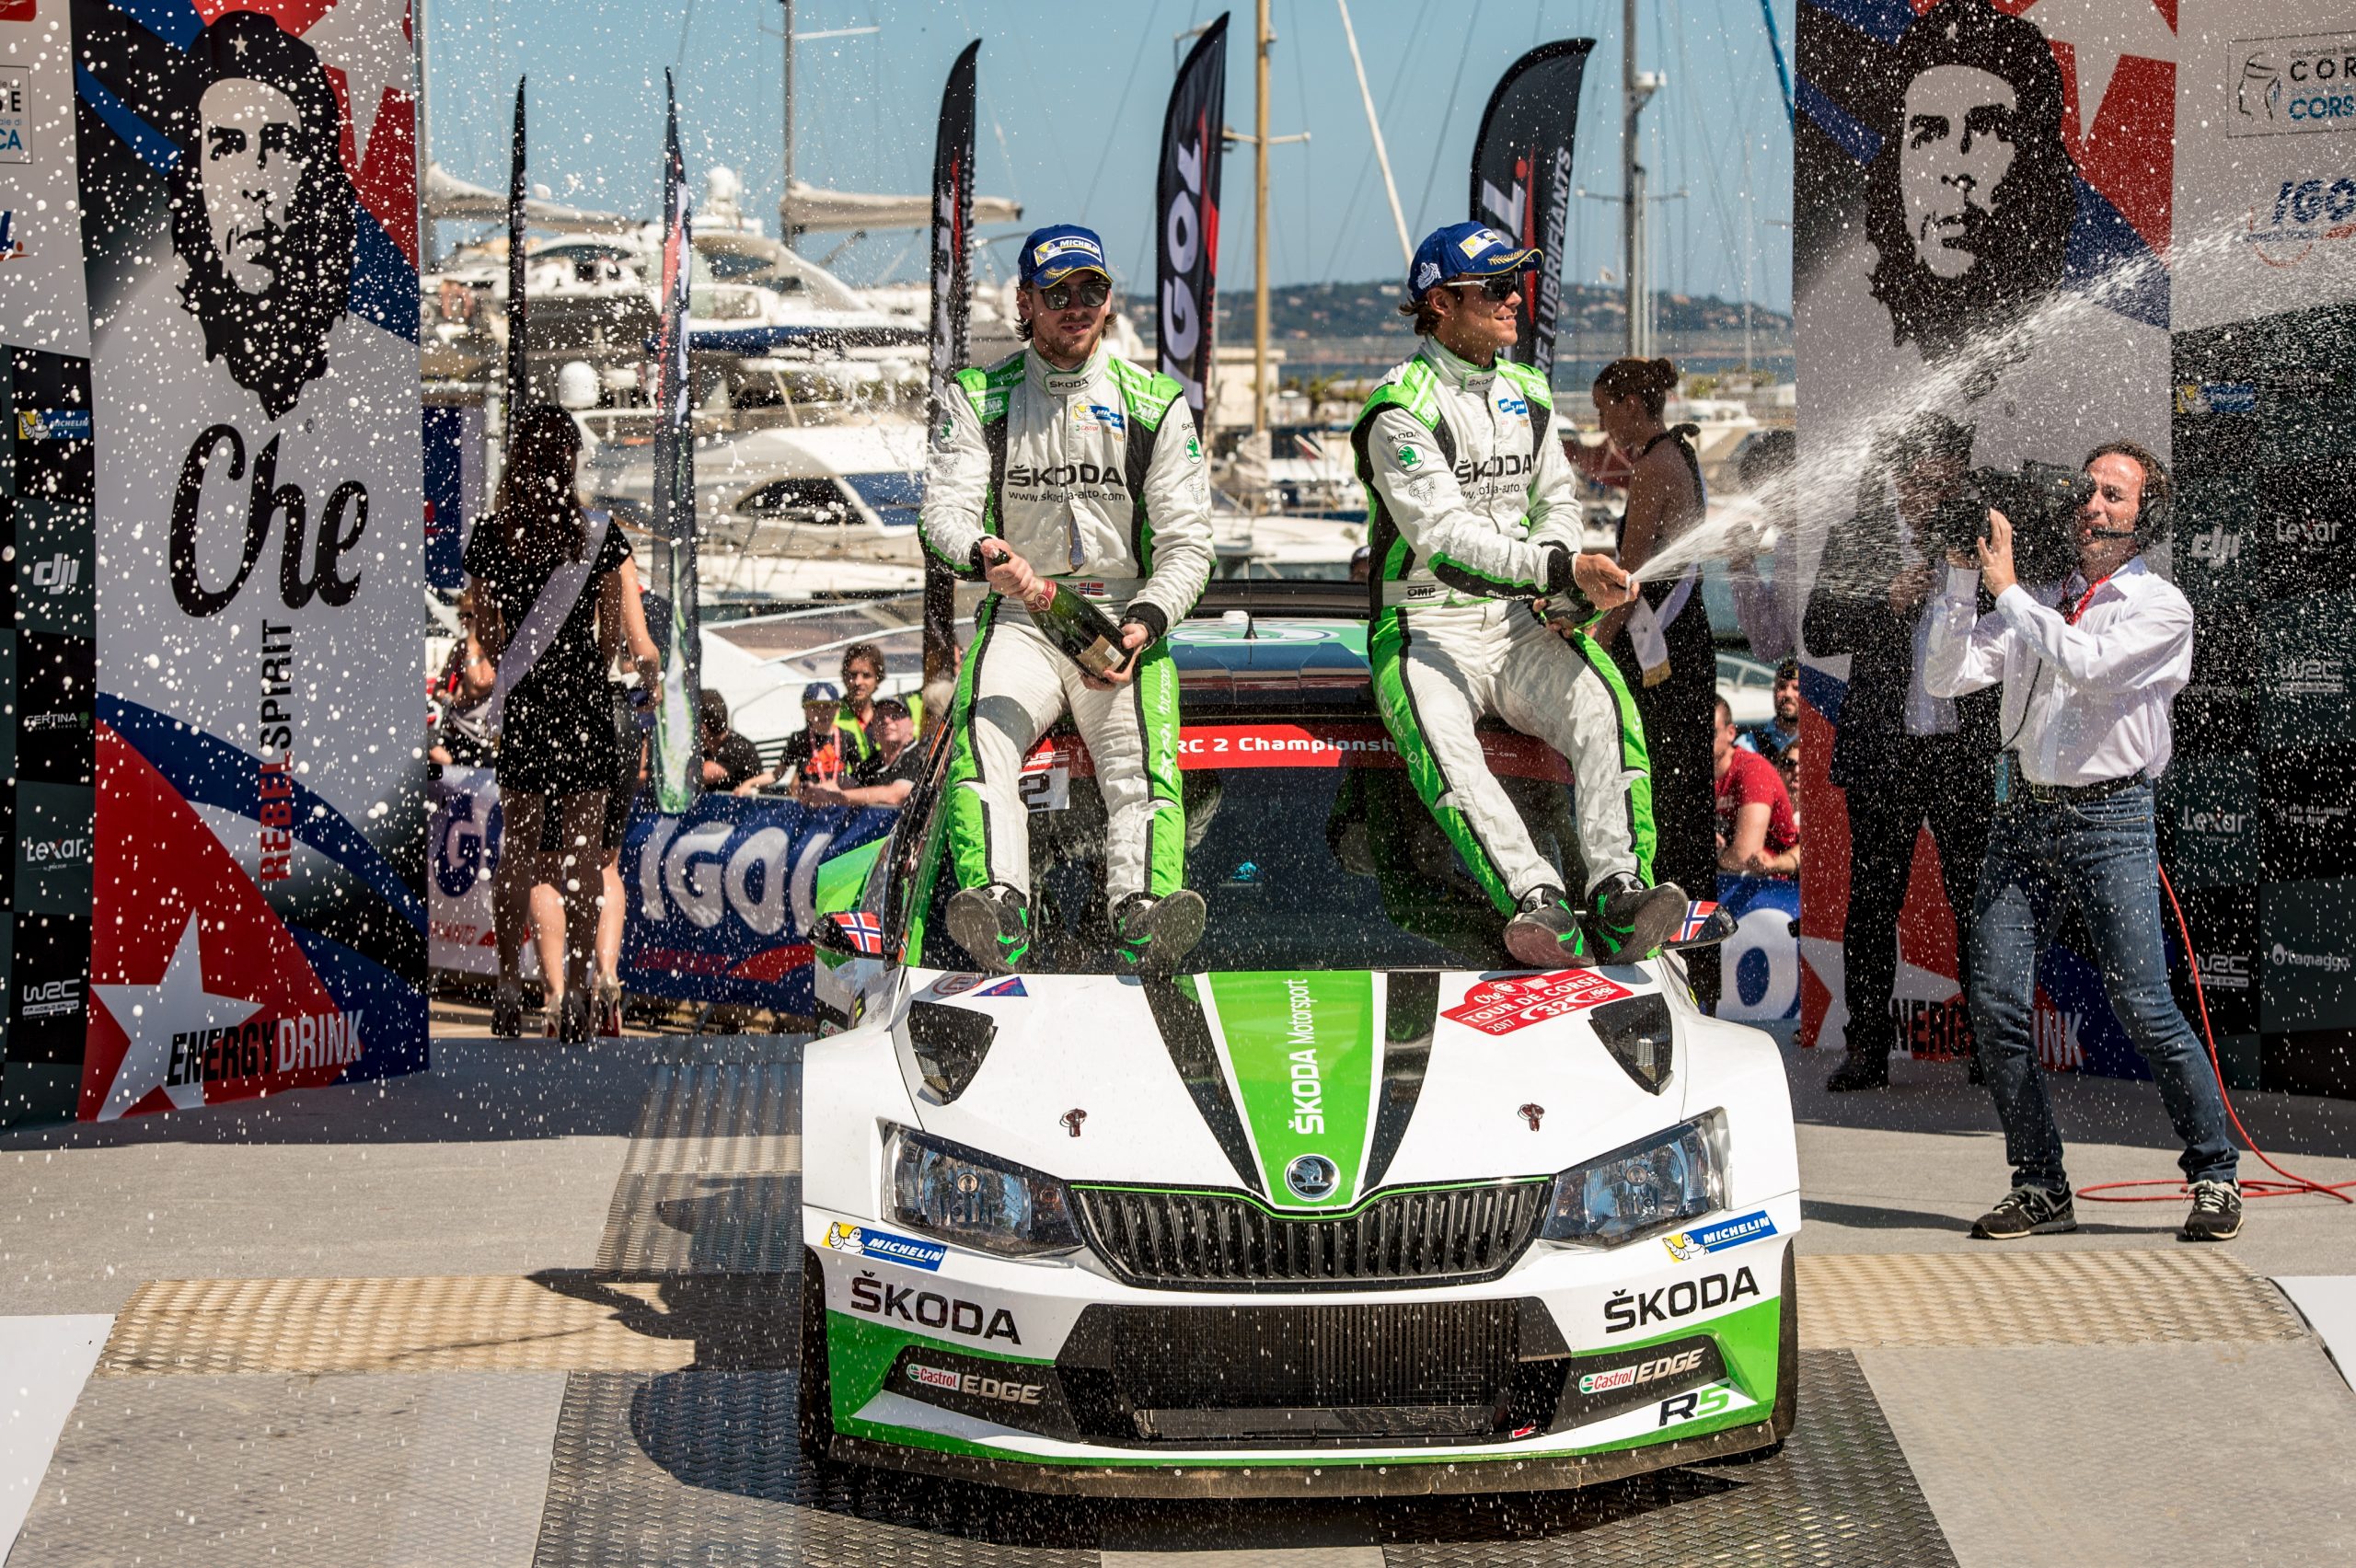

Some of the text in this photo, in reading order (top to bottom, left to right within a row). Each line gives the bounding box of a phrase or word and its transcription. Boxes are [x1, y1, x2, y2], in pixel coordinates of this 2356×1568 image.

[1537, 145, 1572, 339] LUBRIFIANTS
[1007, 464, 1125, 488] ŠKODA
[169, 423, 368, 618] Che
[33, 553, 80, 595] dji
[1407, 587, 1436, 596] OMP
[259, 618, 293, 882] REBEL SPIRIT
[1214, 739, 1228, 752] 2
[27, 836, 85, 862] Lexar
[1462, 1002, 1519, 1024] TOUR
[1516, 993, 1545, 1007] DE
[1543, 975, 1603, 997] CORSE
[1473, 991, 1506, 1006] Che
[1537, 1000, 1577, 1017] 32
[1486, 1019, 1516, 1033] 2017
[167, 1009, 364, 1088] ENERGY DRINK
[1282, 978, 1324, 1135] ŠKODA Motorsport
[867, 1237, 944, 1263] MICHELIN
[1702, 1216, 1772, 1244] MICHELIN
[849, 1269, 1022, 1346] ŠKODA
[1604, 1265, 1761, 1334] ŠKODA
[919, 1368, 1045, 1406] Castrol EDGE
[1593, 1346, 1707, 1391] Castrol EDGE
[1658, 1382, 1732, 1427] R5
